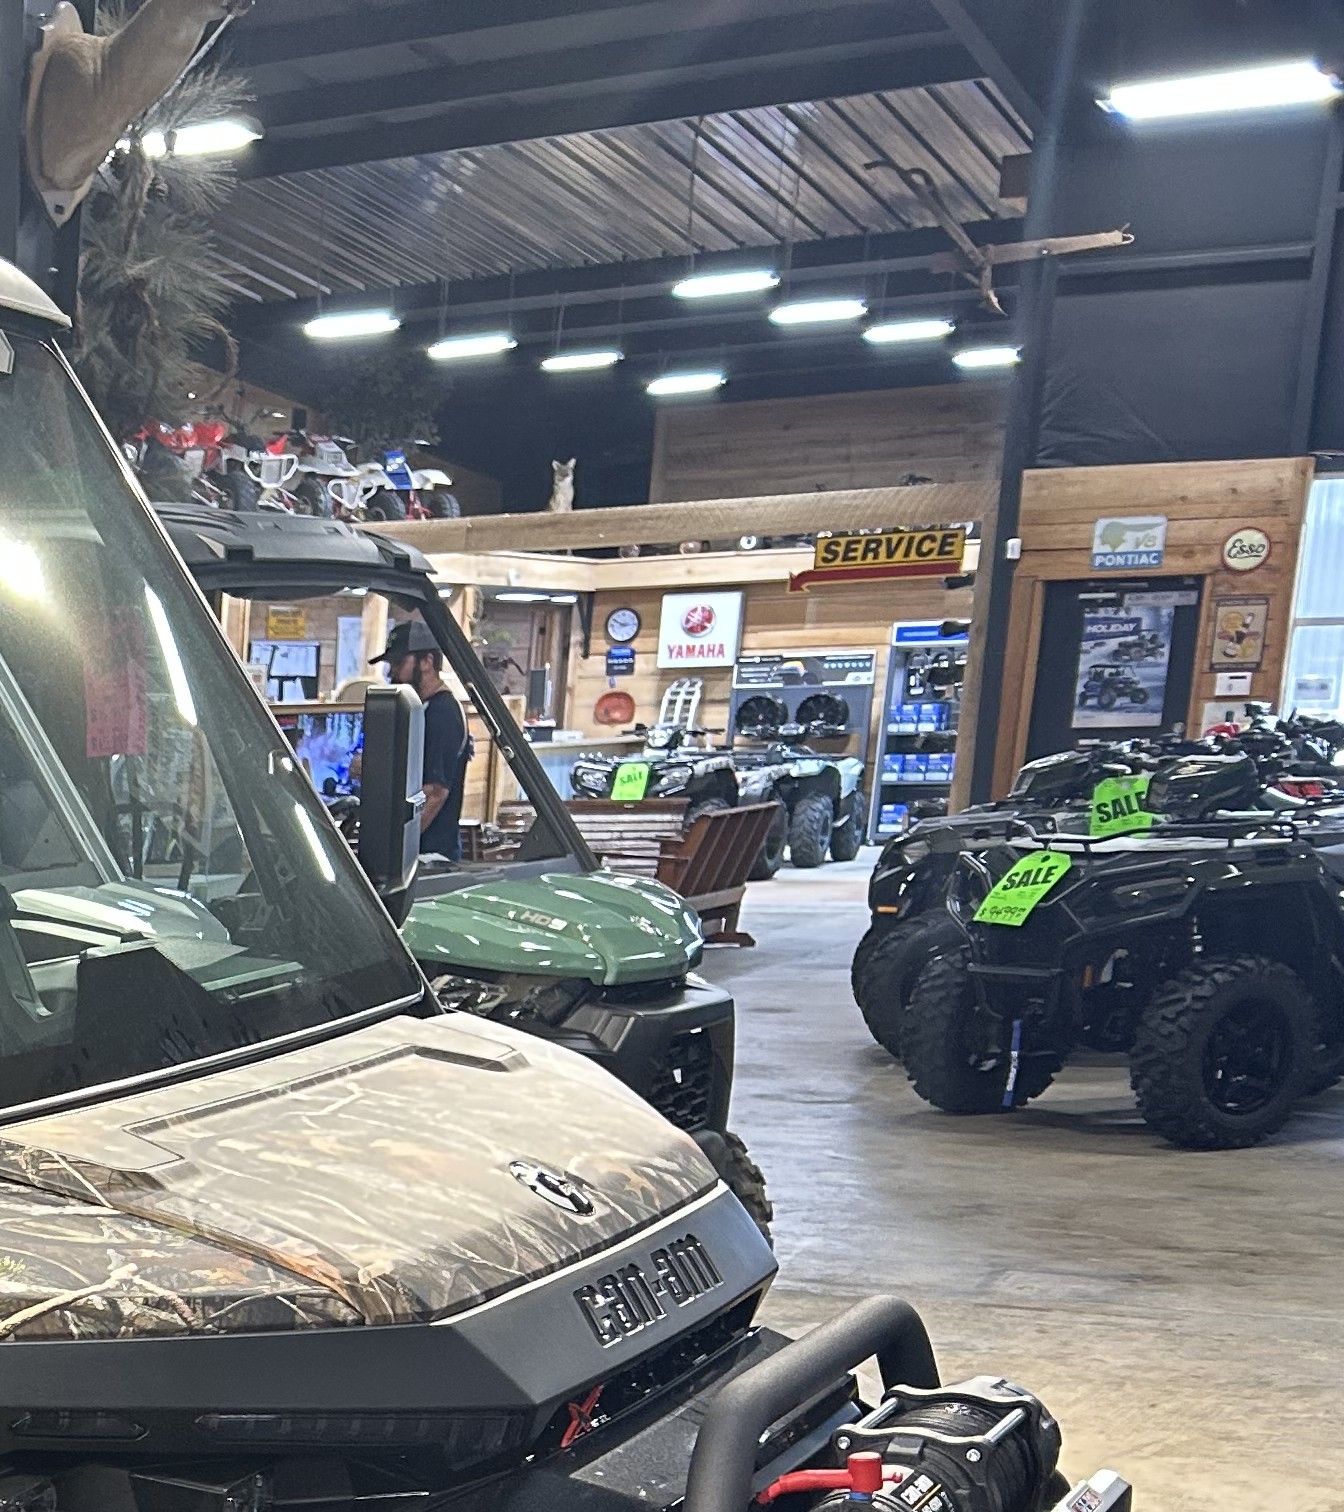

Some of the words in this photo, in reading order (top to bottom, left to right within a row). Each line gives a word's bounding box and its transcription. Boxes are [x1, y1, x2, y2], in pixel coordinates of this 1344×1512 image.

[821, 533, 959, 565] SERVICE
[1133, 534, 1156, 549] V8
[1227, 538, 1266, 559] Esso
[1094, 551, 1160, 567] PONTIAC
[1086, 622, 1138, 633] HOLIDAY
[667, 643, 725, 659] YAMAHA
[1002, 865, 1059, 891] SALE
[572, 1233, 726, 1349] can-am
